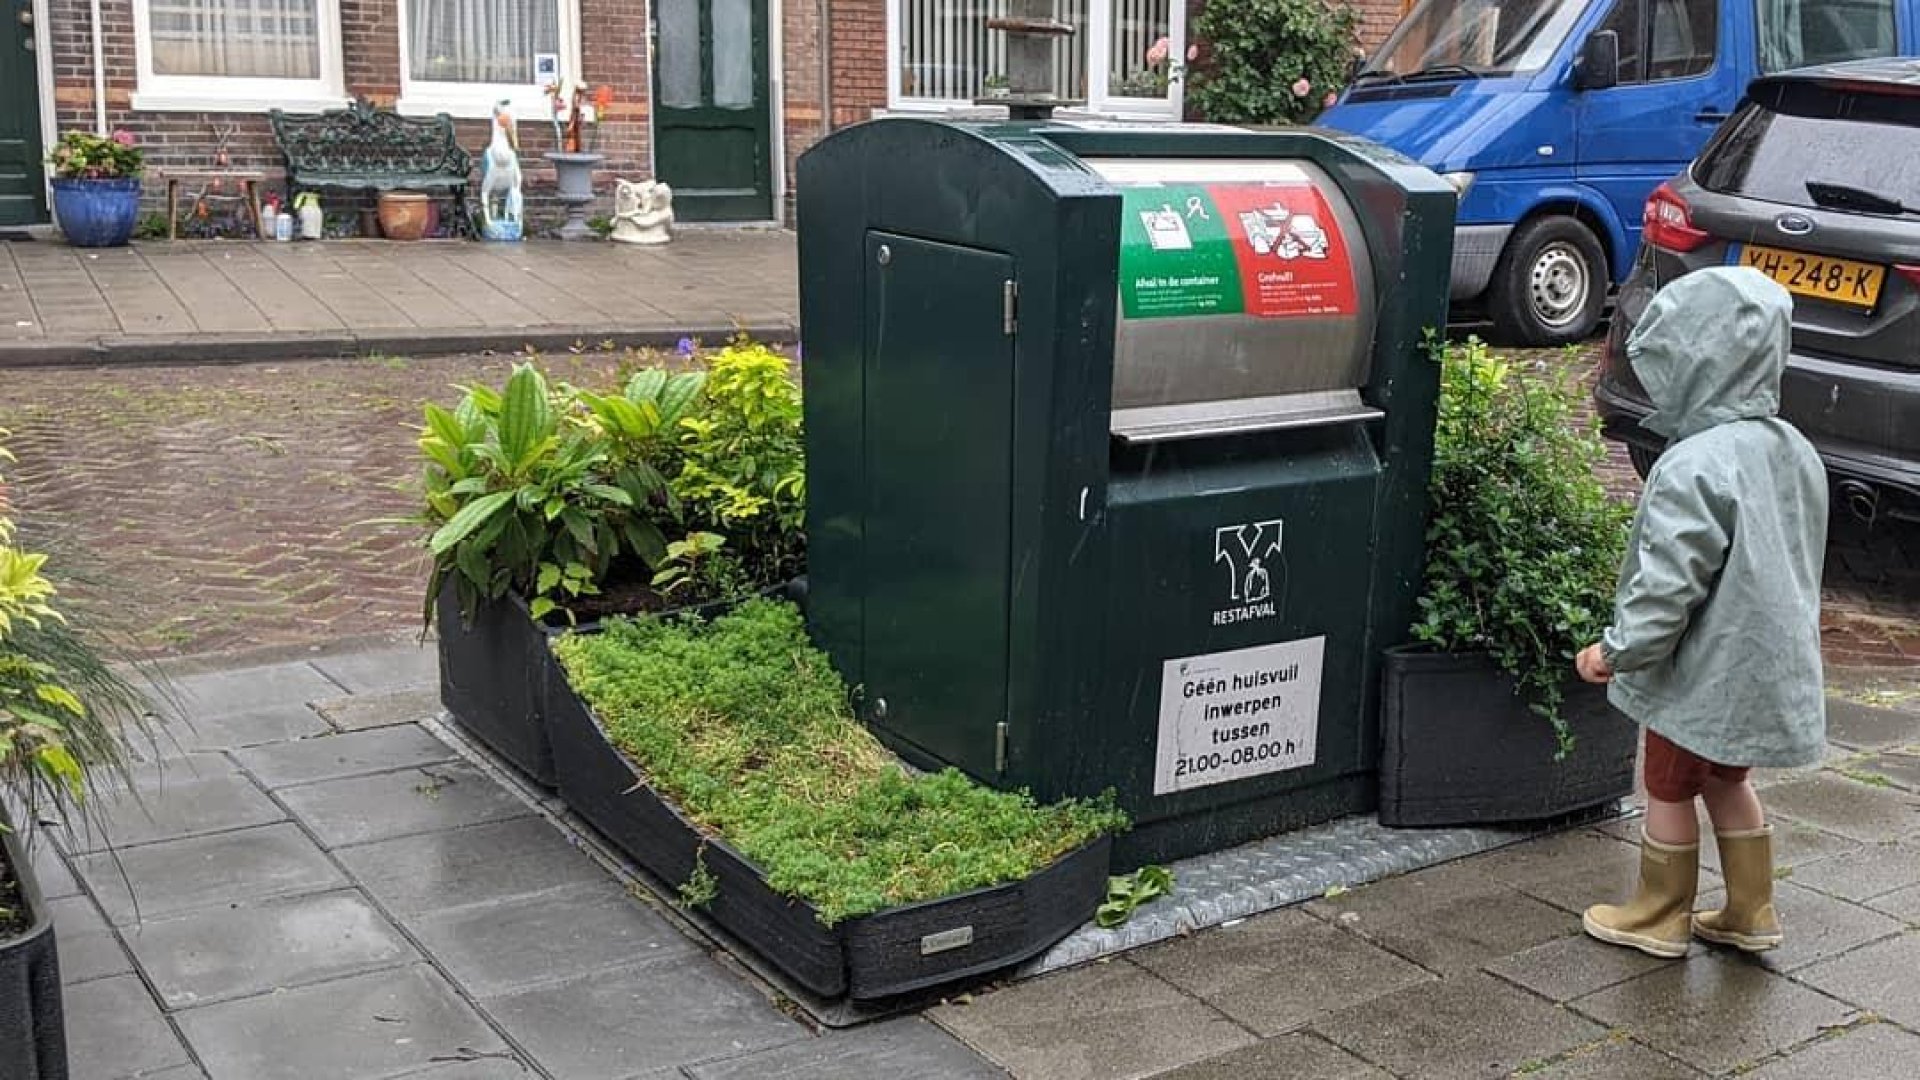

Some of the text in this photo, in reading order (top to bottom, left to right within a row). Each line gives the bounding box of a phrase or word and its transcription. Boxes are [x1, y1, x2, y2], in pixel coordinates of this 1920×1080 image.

[1213, 601, 1276, 626] RESTAFVAL
[1233, 663, 1299, 692] huisvuil
[1204, 695, 1282, 722] inwerpen
[1212, 722, 1270, 745] tussen
[1175, 738, 1296, 777] 21.00-08.00 h
